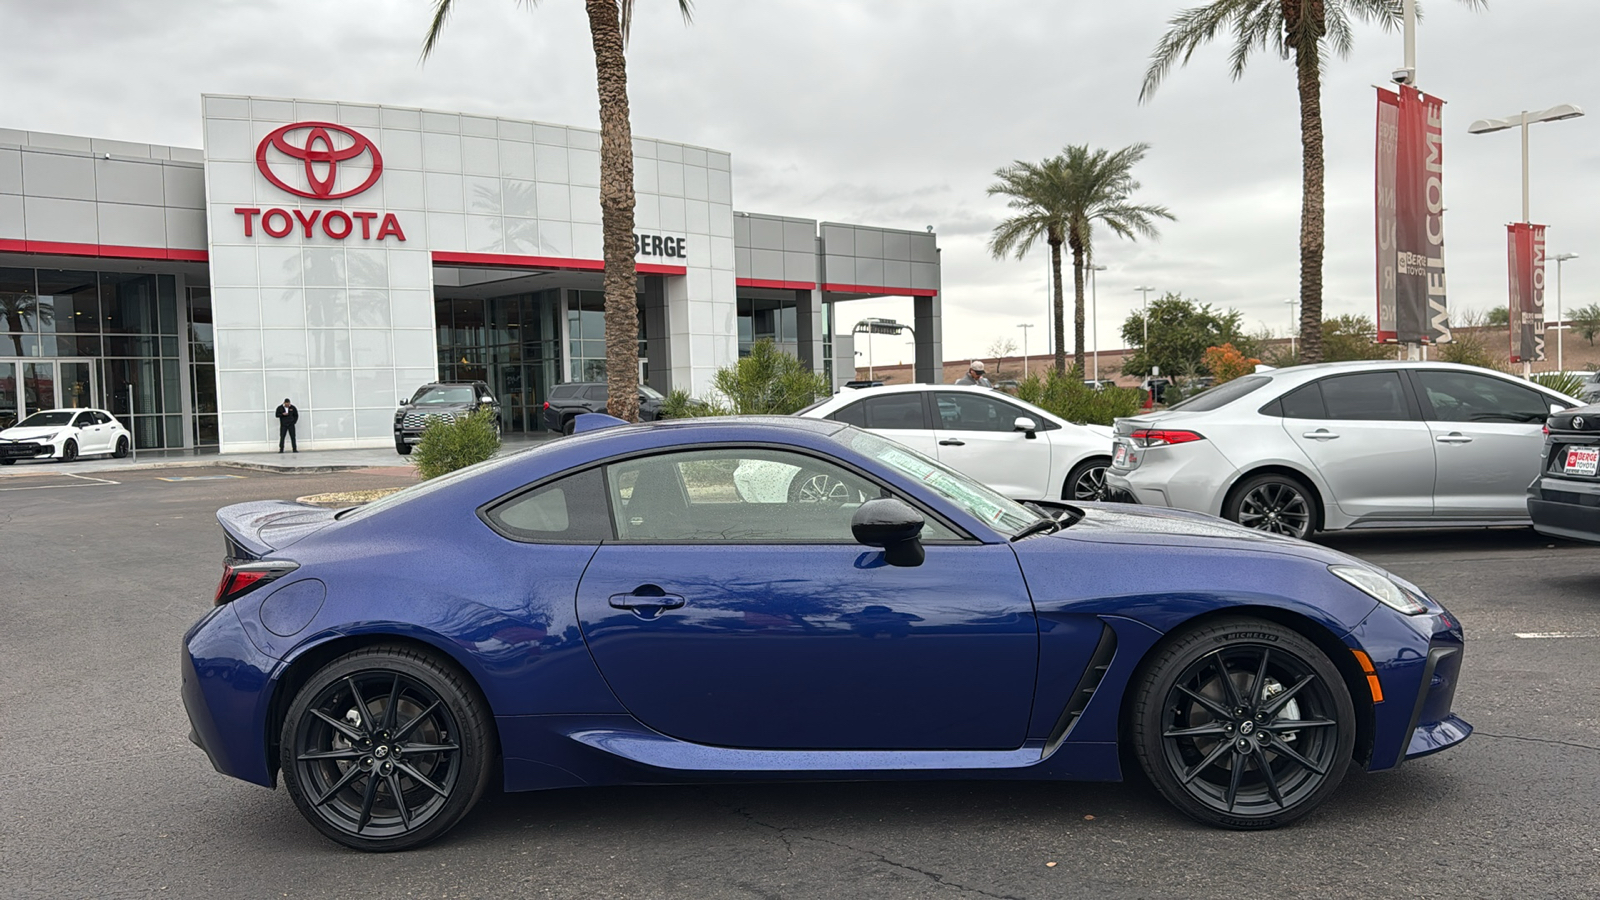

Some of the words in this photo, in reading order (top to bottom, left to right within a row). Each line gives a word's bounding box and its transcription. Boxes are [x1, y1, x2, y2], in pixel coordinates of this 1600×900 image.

[234, 207, 406, 242] TOYOTA
[1426, 102, 1452, 343] WELCOME
[1534, 228, 1545, 361] WELCOME
[1577, 452, 1597, 462] BERGE
[1227, 631, 1277, 642] MICHELIN
